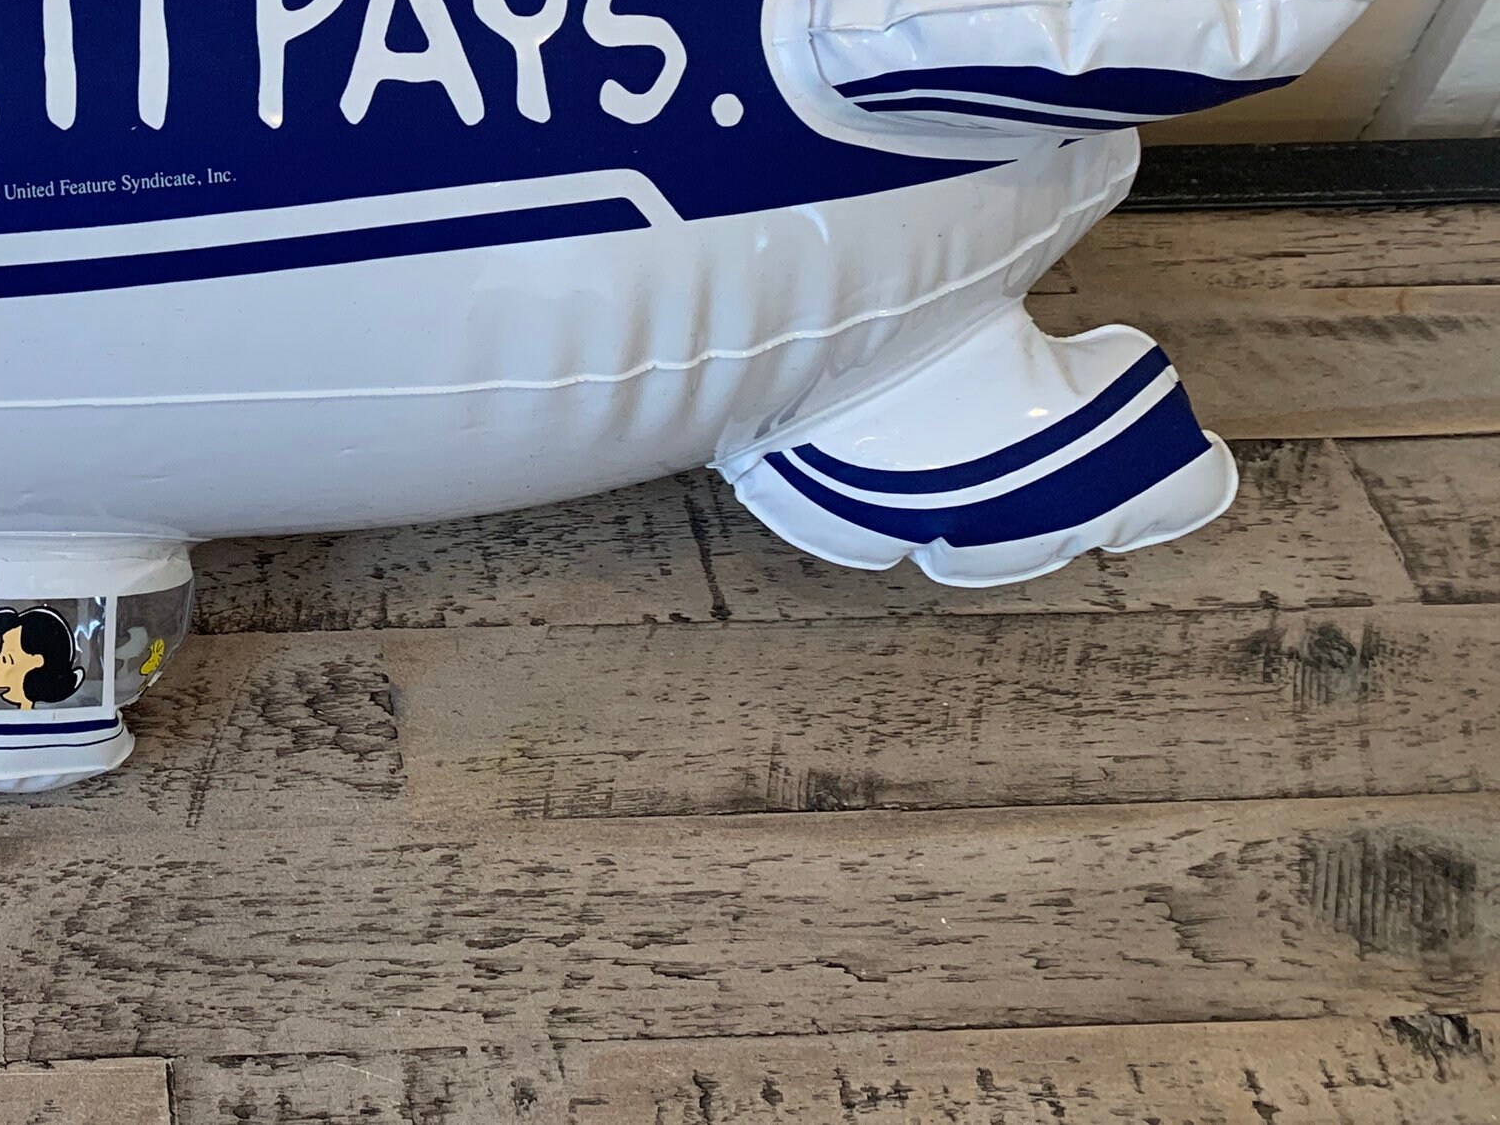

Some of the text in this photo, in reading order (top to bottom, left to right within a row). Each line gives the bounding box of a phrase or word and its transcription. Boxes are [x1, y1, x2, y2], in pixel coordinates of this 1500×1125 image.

[4, 180, 55, 200] United
[59, 179, 117, 196] Feature
[121, 172, 202, 194] Syndicate,
[207, 168, 237, 184] Inc.
